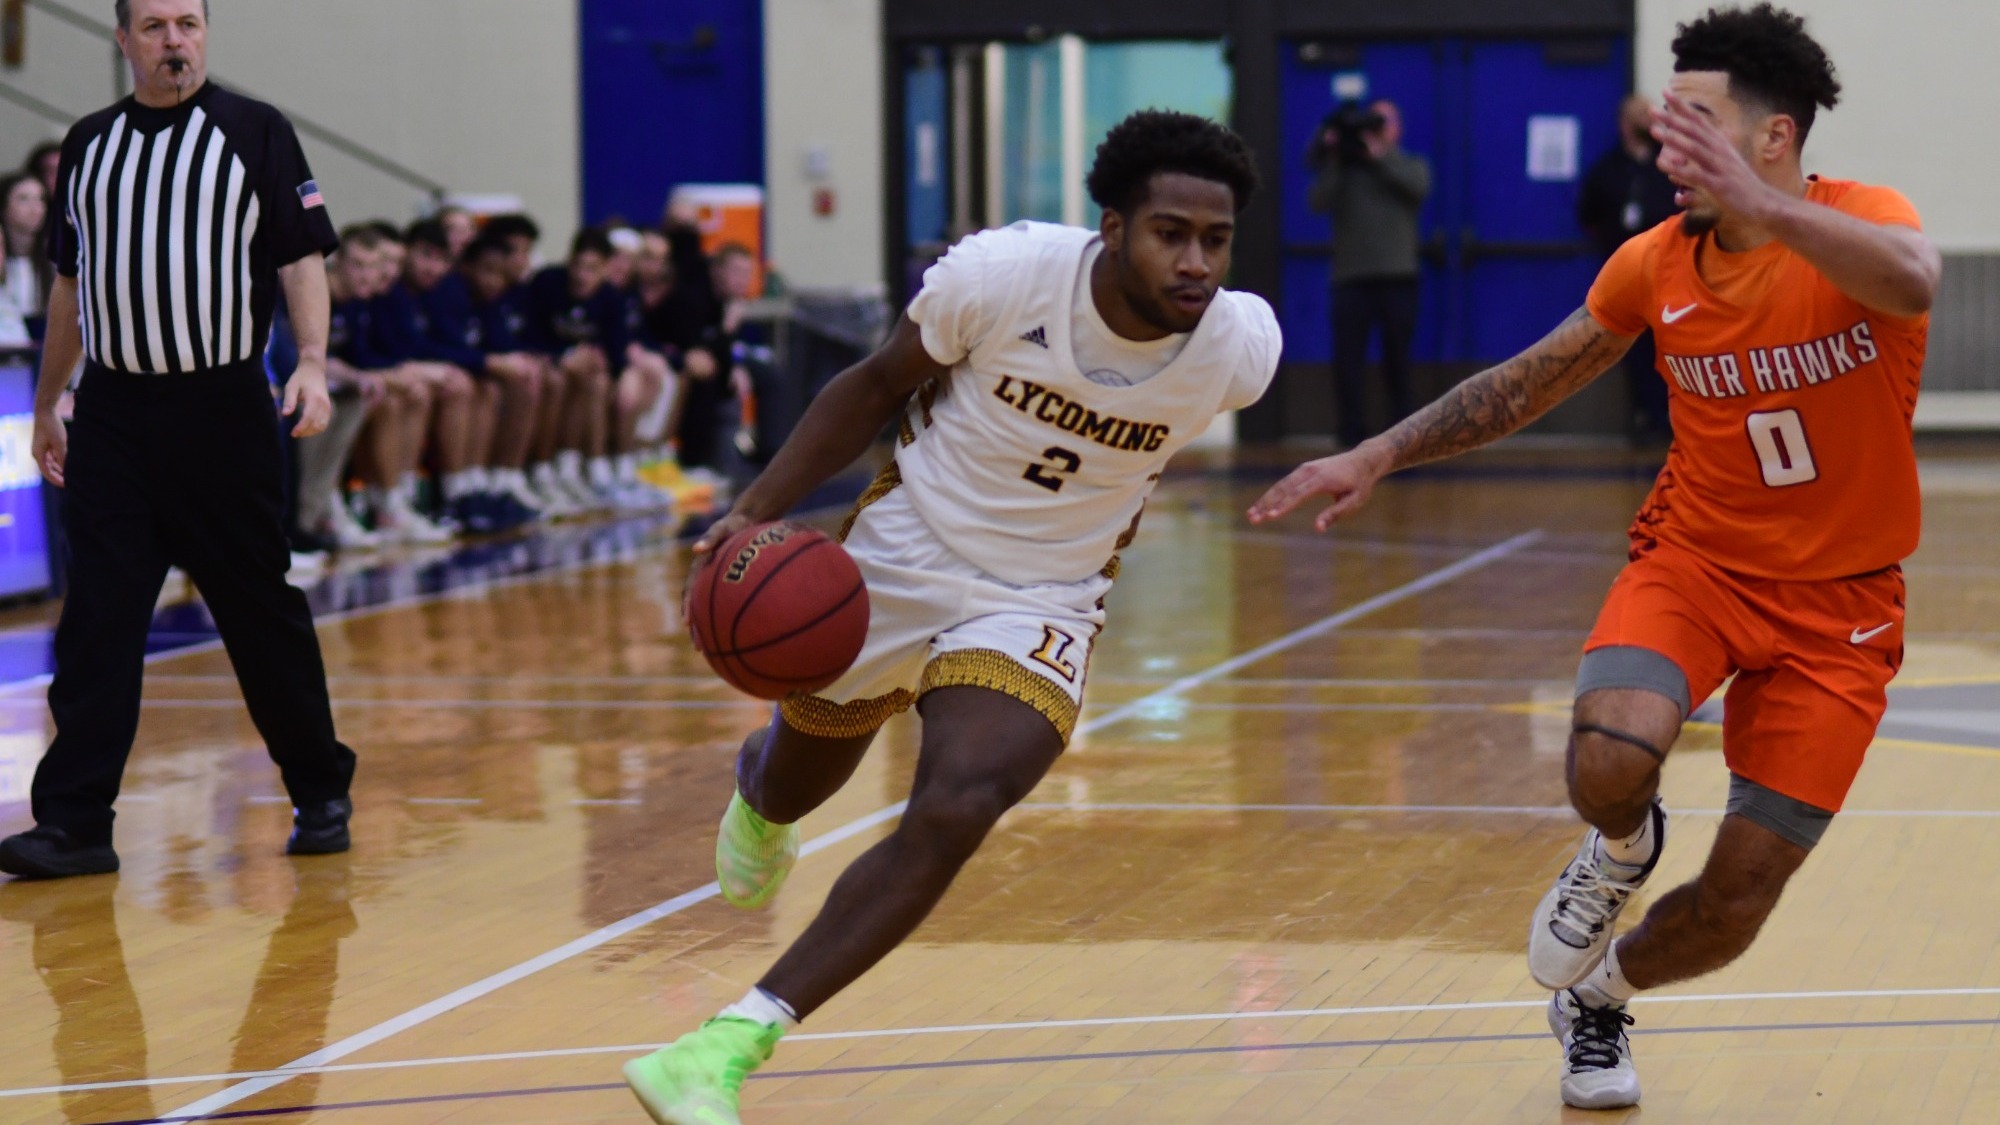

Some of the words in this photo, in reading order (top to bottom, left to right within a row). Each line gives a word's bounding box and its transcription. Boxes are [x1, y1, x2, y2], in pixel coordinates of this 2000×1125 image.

[1664, 353, 1747, 398] RIVER
[1748, 321, 1878, 392] HAWKS
[992, 373, 1171, 453] LYCOMING
[1745, 408, 1819, 488] 0
[1021, 446, 1082, 493] 2
[1027, 623, 1077, 684] L
